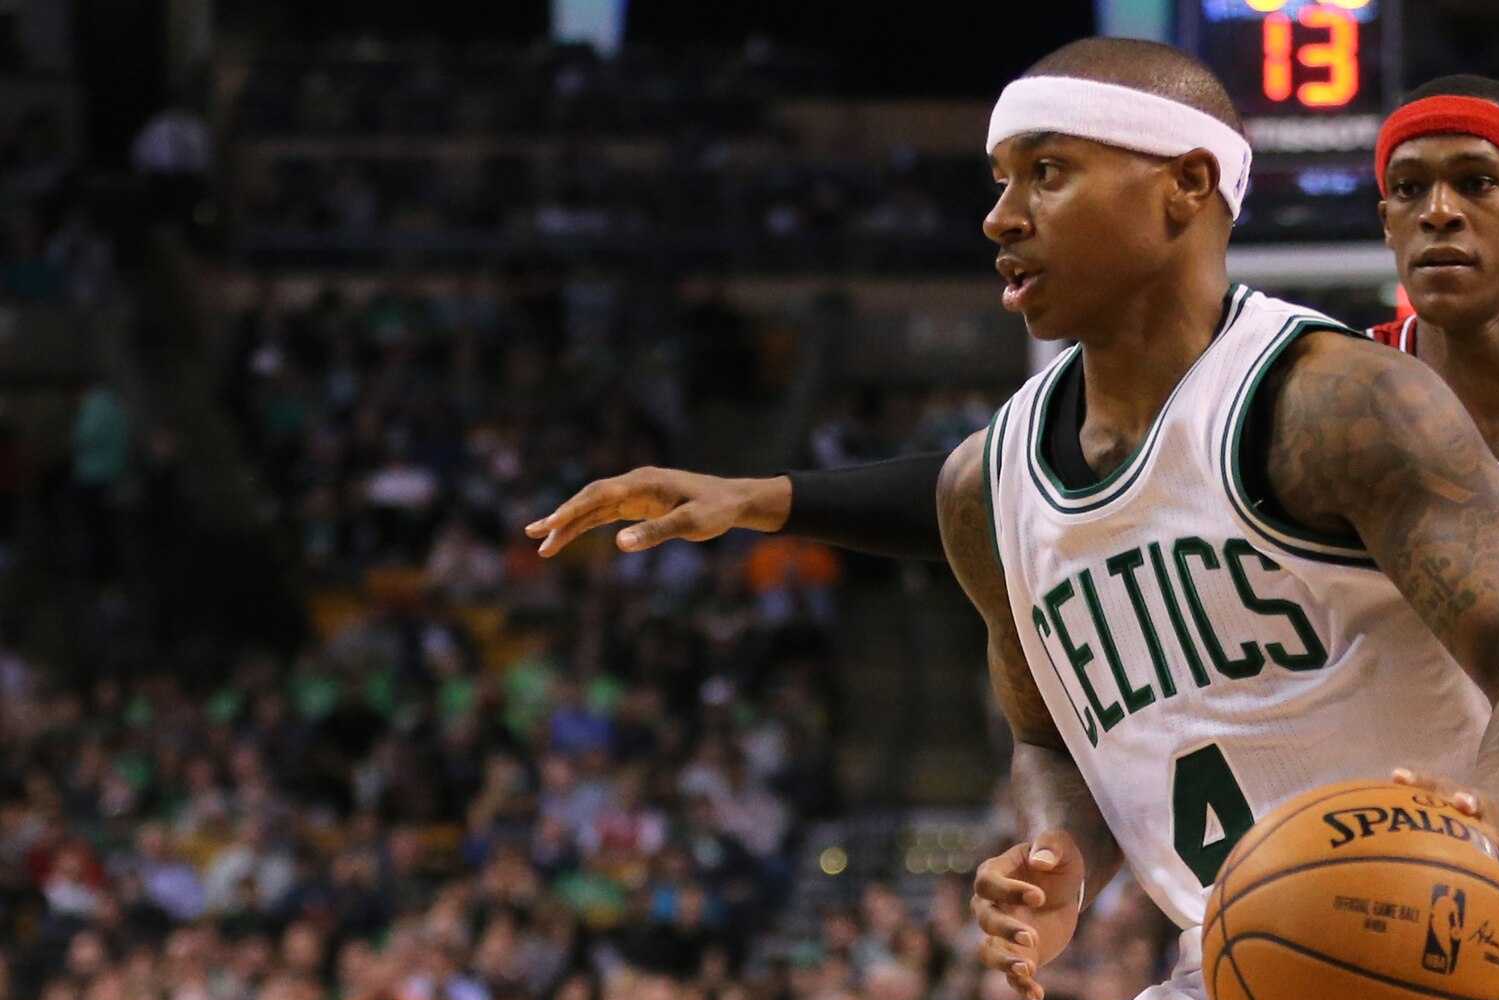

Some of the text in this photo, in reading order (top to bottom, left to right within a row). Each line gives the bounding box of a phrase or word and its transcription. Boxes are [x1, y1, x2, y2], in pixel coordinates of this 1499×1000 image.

[1262, 3, 1360, 108] 13
[1032, 535, 1329, 749] CELTICS
[1169, 737, 1257, 889] 4
